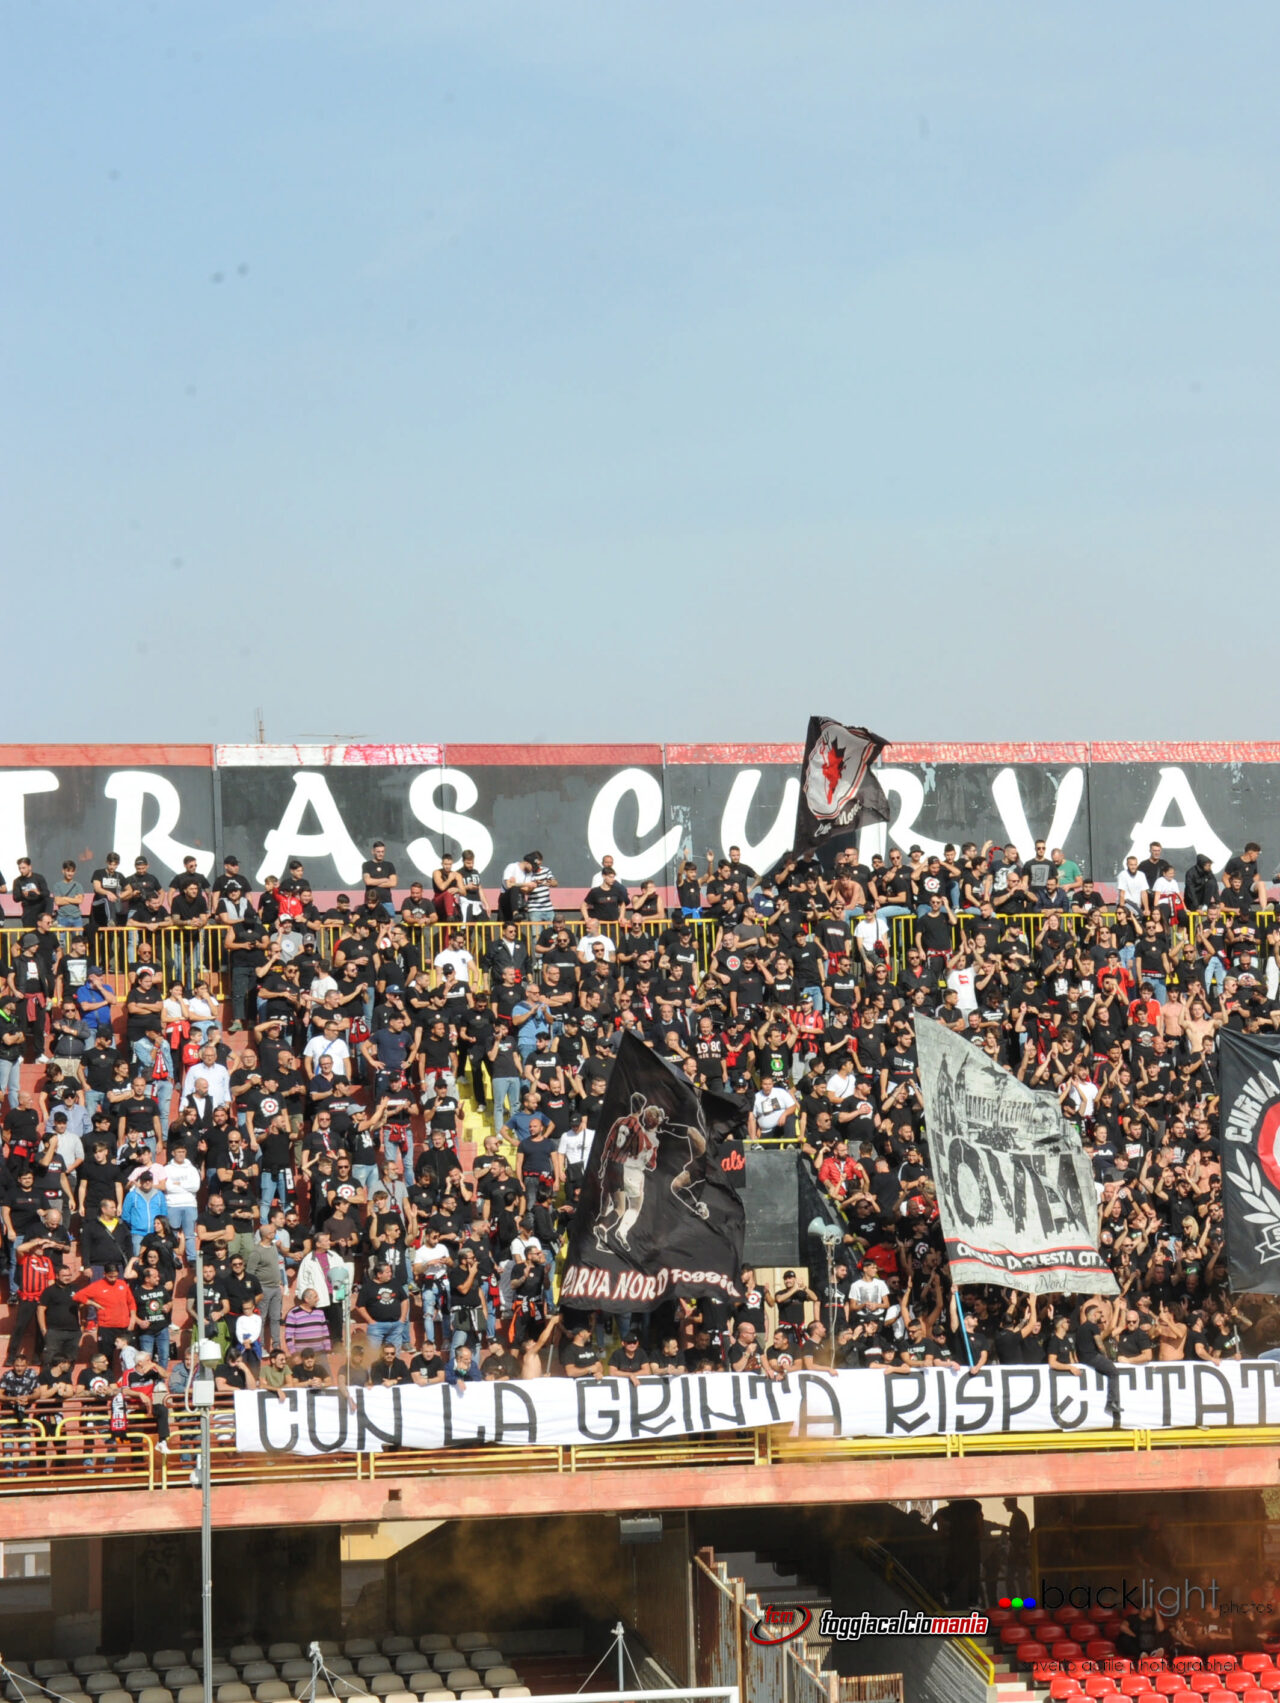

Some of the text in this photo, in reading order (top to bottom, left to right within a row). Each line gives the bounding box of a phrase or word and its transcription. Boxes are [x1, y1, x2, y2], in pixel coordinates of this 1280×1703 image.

[587, 766, 1232, 884] CURVA
[1225, 1070, 1280, 1143] CURVA
[613, 1268, 668, 1299] NORD
[1022, 1251, 1075, 1269] QUESTA
[258, 1386, 402, 1453] CON
[442, 1381, 537, 1447] LA
[577, 1373, 841, 1442] GRINTA
